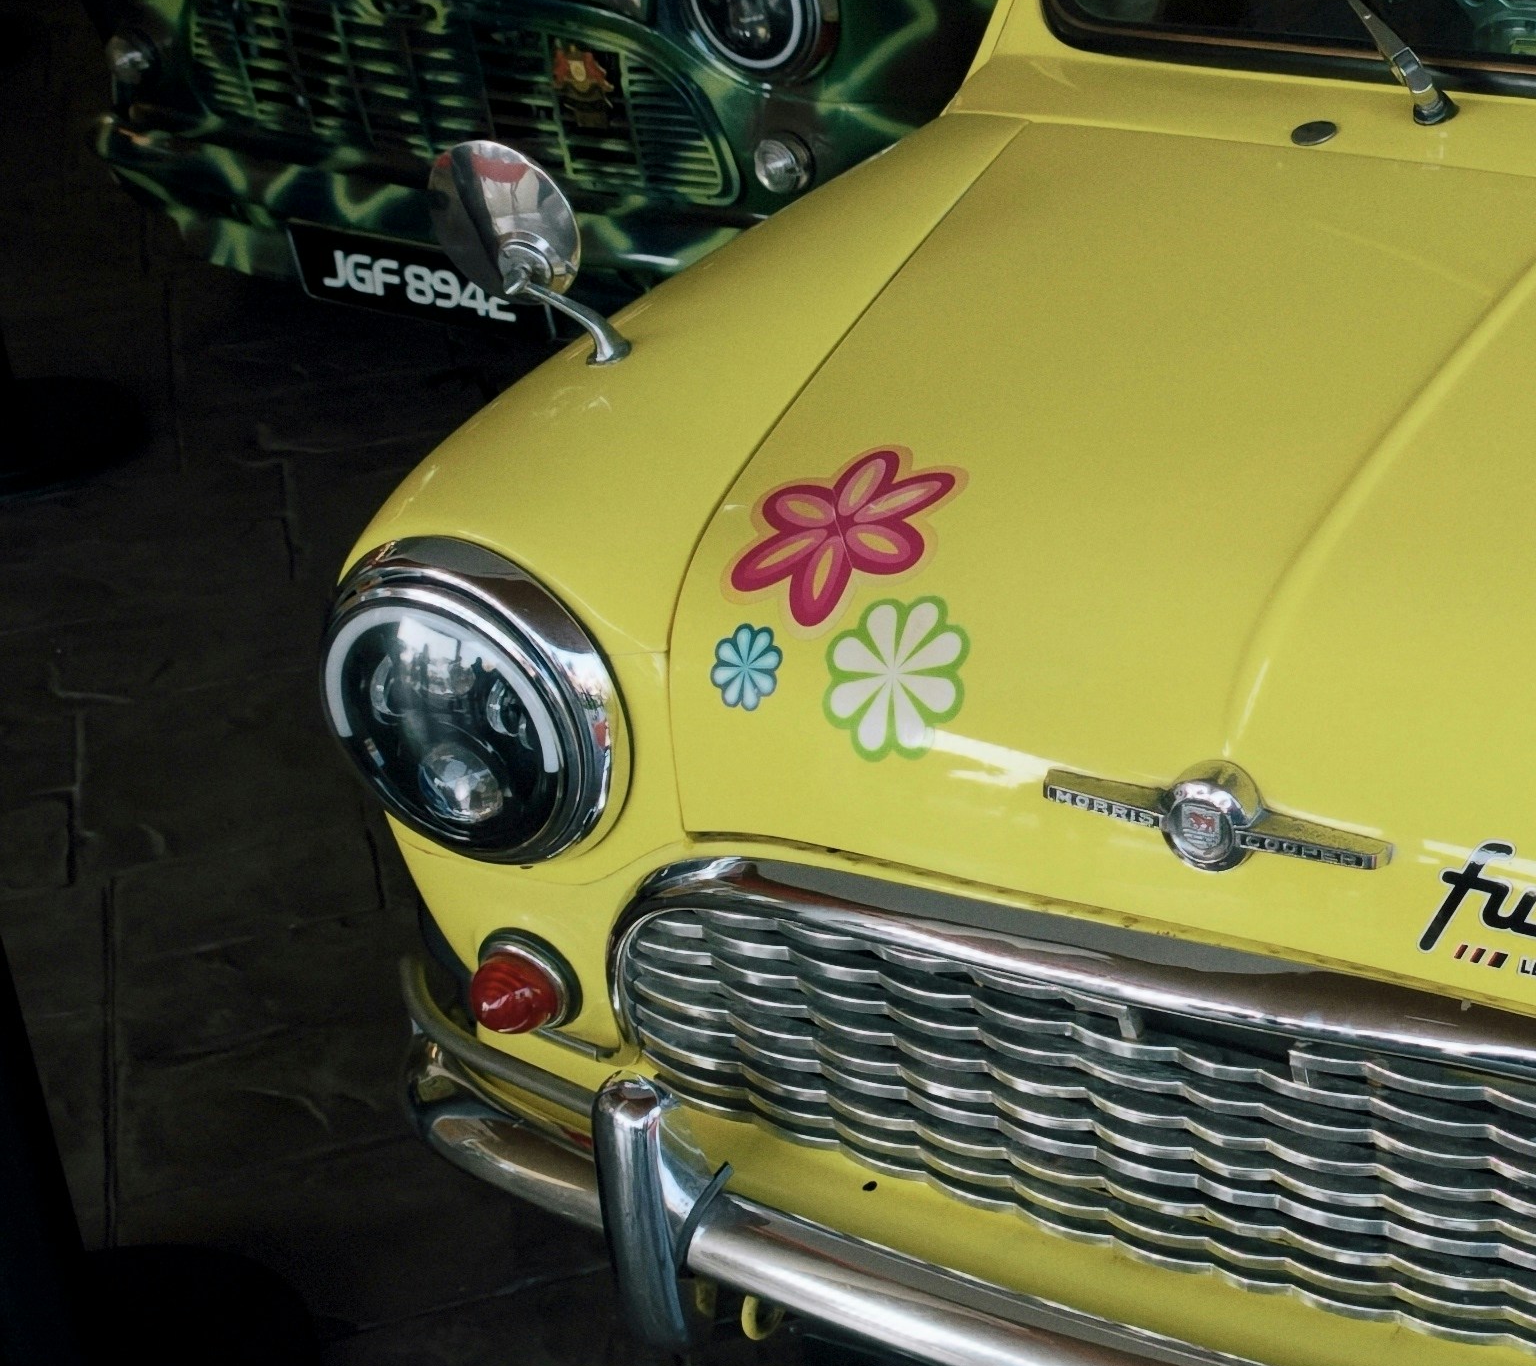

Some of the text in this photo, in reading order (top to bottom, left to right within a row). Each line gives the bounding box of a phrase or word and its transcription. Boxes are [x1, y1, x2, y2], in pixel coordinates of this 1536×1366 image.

[321, 249, 401, 297] JGF
[1056, 789, 1156, 826] MORRIS
[1243, 833, 1361, 866] COOPER
